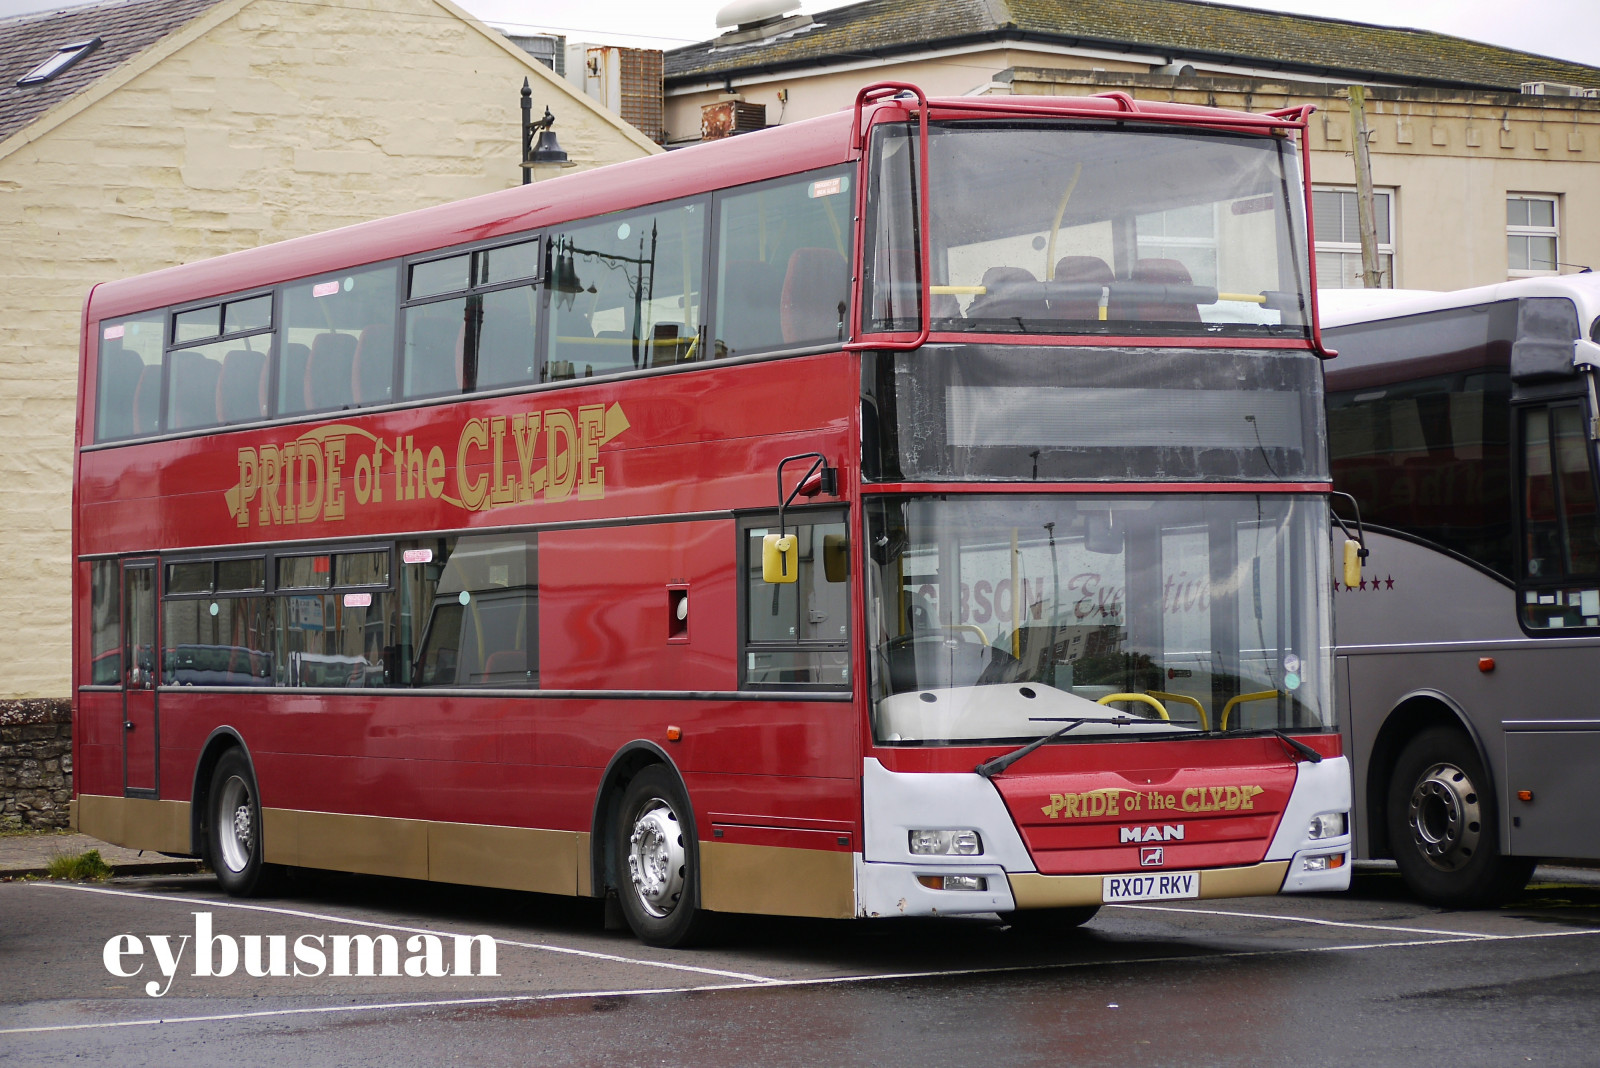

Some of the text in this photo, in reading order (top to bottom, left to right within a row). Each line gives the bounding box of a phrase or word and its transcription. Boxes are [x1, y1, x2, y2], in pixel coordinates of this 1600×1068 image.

[237, 403, 605, 527] PRIDE of the CLYDE
[1068, 571, 1212, 618] Exetive
[1050, 785, 1253, 818] PRIDE of the CLYDE
[1120, 824, 1184, 843] MAN
[1110, 875, 1192, 897] RX07 RKV
